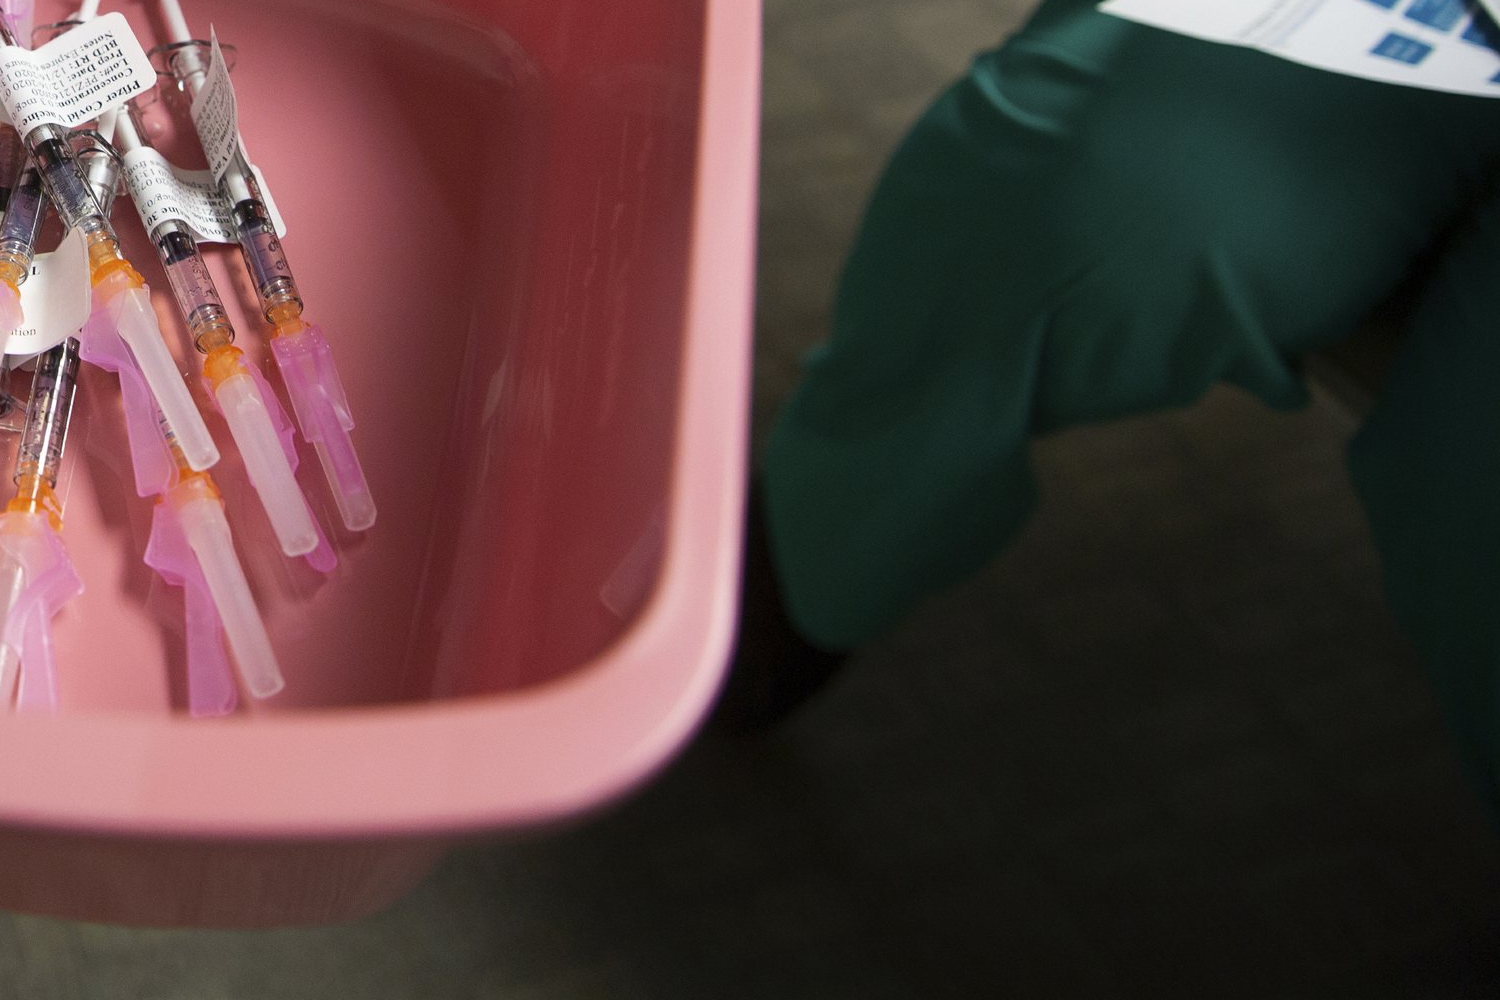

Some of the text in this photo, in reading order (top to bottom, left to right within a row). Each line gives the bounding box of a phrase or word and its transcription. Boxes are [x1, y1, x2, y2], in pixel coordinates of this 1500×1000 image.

[79, 30, 114, 53] Notes:
[92, 39, 118, 58] BUD
[40, 47, 79, 74] Expires
[68, 54, 90, 70] RT:
[96, 47, 124, 67] Prep
[99, 57, 129, 78] Lot#:
[67, 63, 96, 84] Date:
[104, 79, 141, 104] Pfizer
[67, 98, 104, 124] Covid
